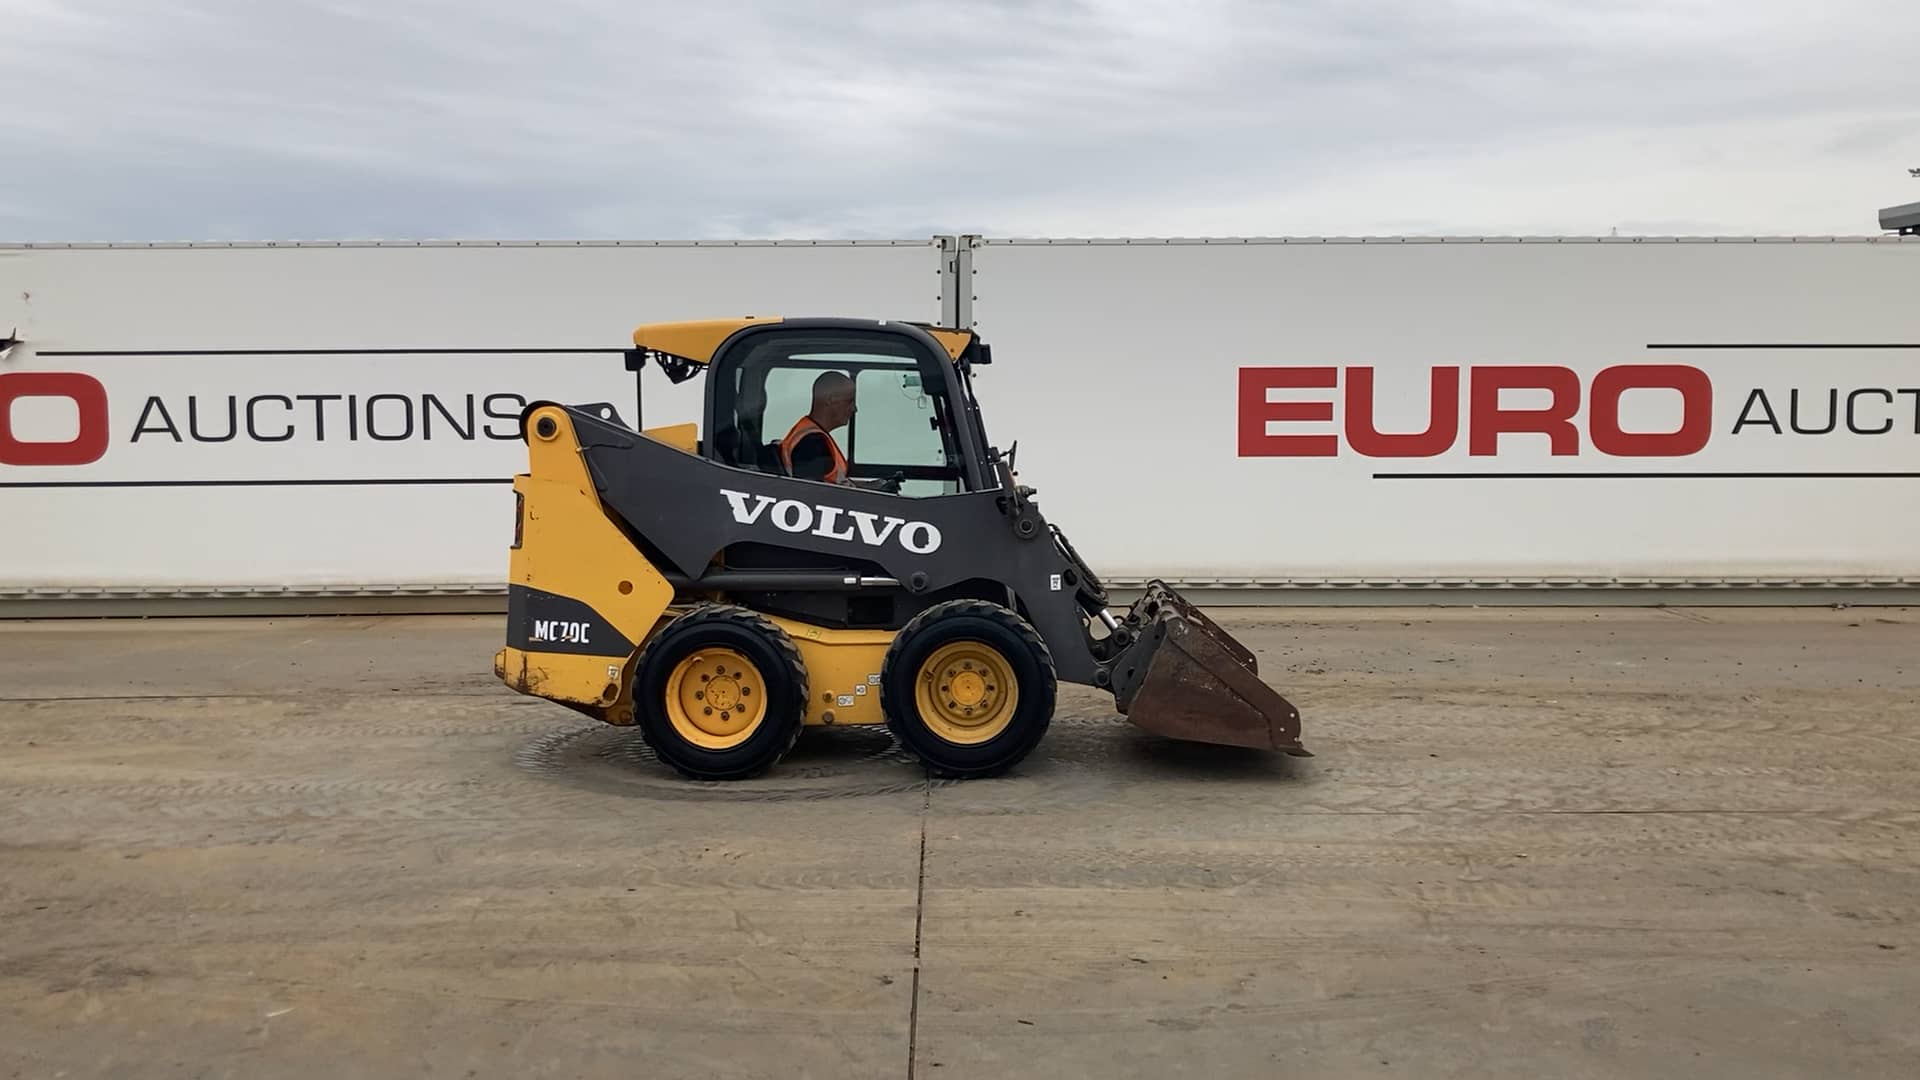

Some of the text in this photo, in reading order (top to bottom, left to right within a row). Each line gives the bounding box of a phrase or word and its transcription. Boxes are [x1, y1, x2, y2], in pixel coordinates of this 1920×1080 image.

[130, 393, 526, 443] AUCTIONS
[1237, 364, 1713, 458] EURO
[719, 488, 942, 554] VOLVO
[535, 620, 590, 643] MC70C
